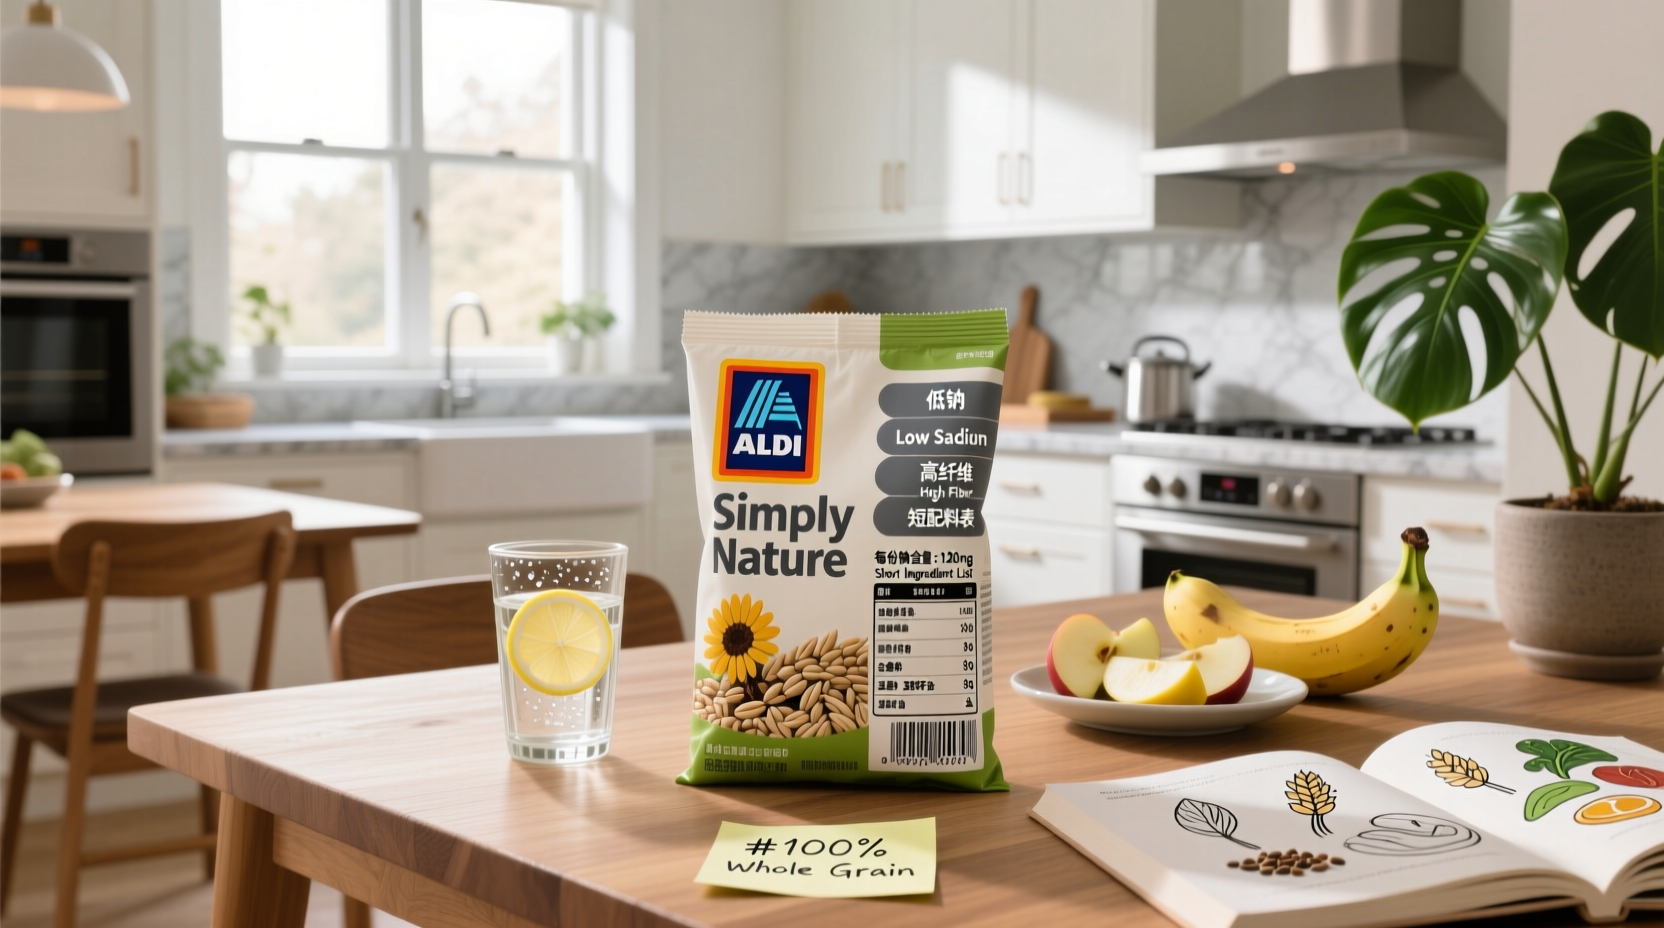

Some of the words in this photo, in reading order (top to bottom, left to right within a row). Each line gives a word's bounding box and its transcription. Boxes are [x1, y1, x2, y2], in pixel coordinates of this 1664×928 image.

[926, 388, 965, 411] 低钠
[732, 433, 802, 457] ALDI
[896, 429, 930, 445] Low
[920, 460, 974, 483] 高纤维
[713, 491, 855, 544] Simply
[907, 507, 974, 528] 短配料表
[713, 537, 847, 578] Nature
[745, 838, 887, 858] #100%
[727, 860, 813, 876] Whole
[830, 863, 915, 879] Grain
